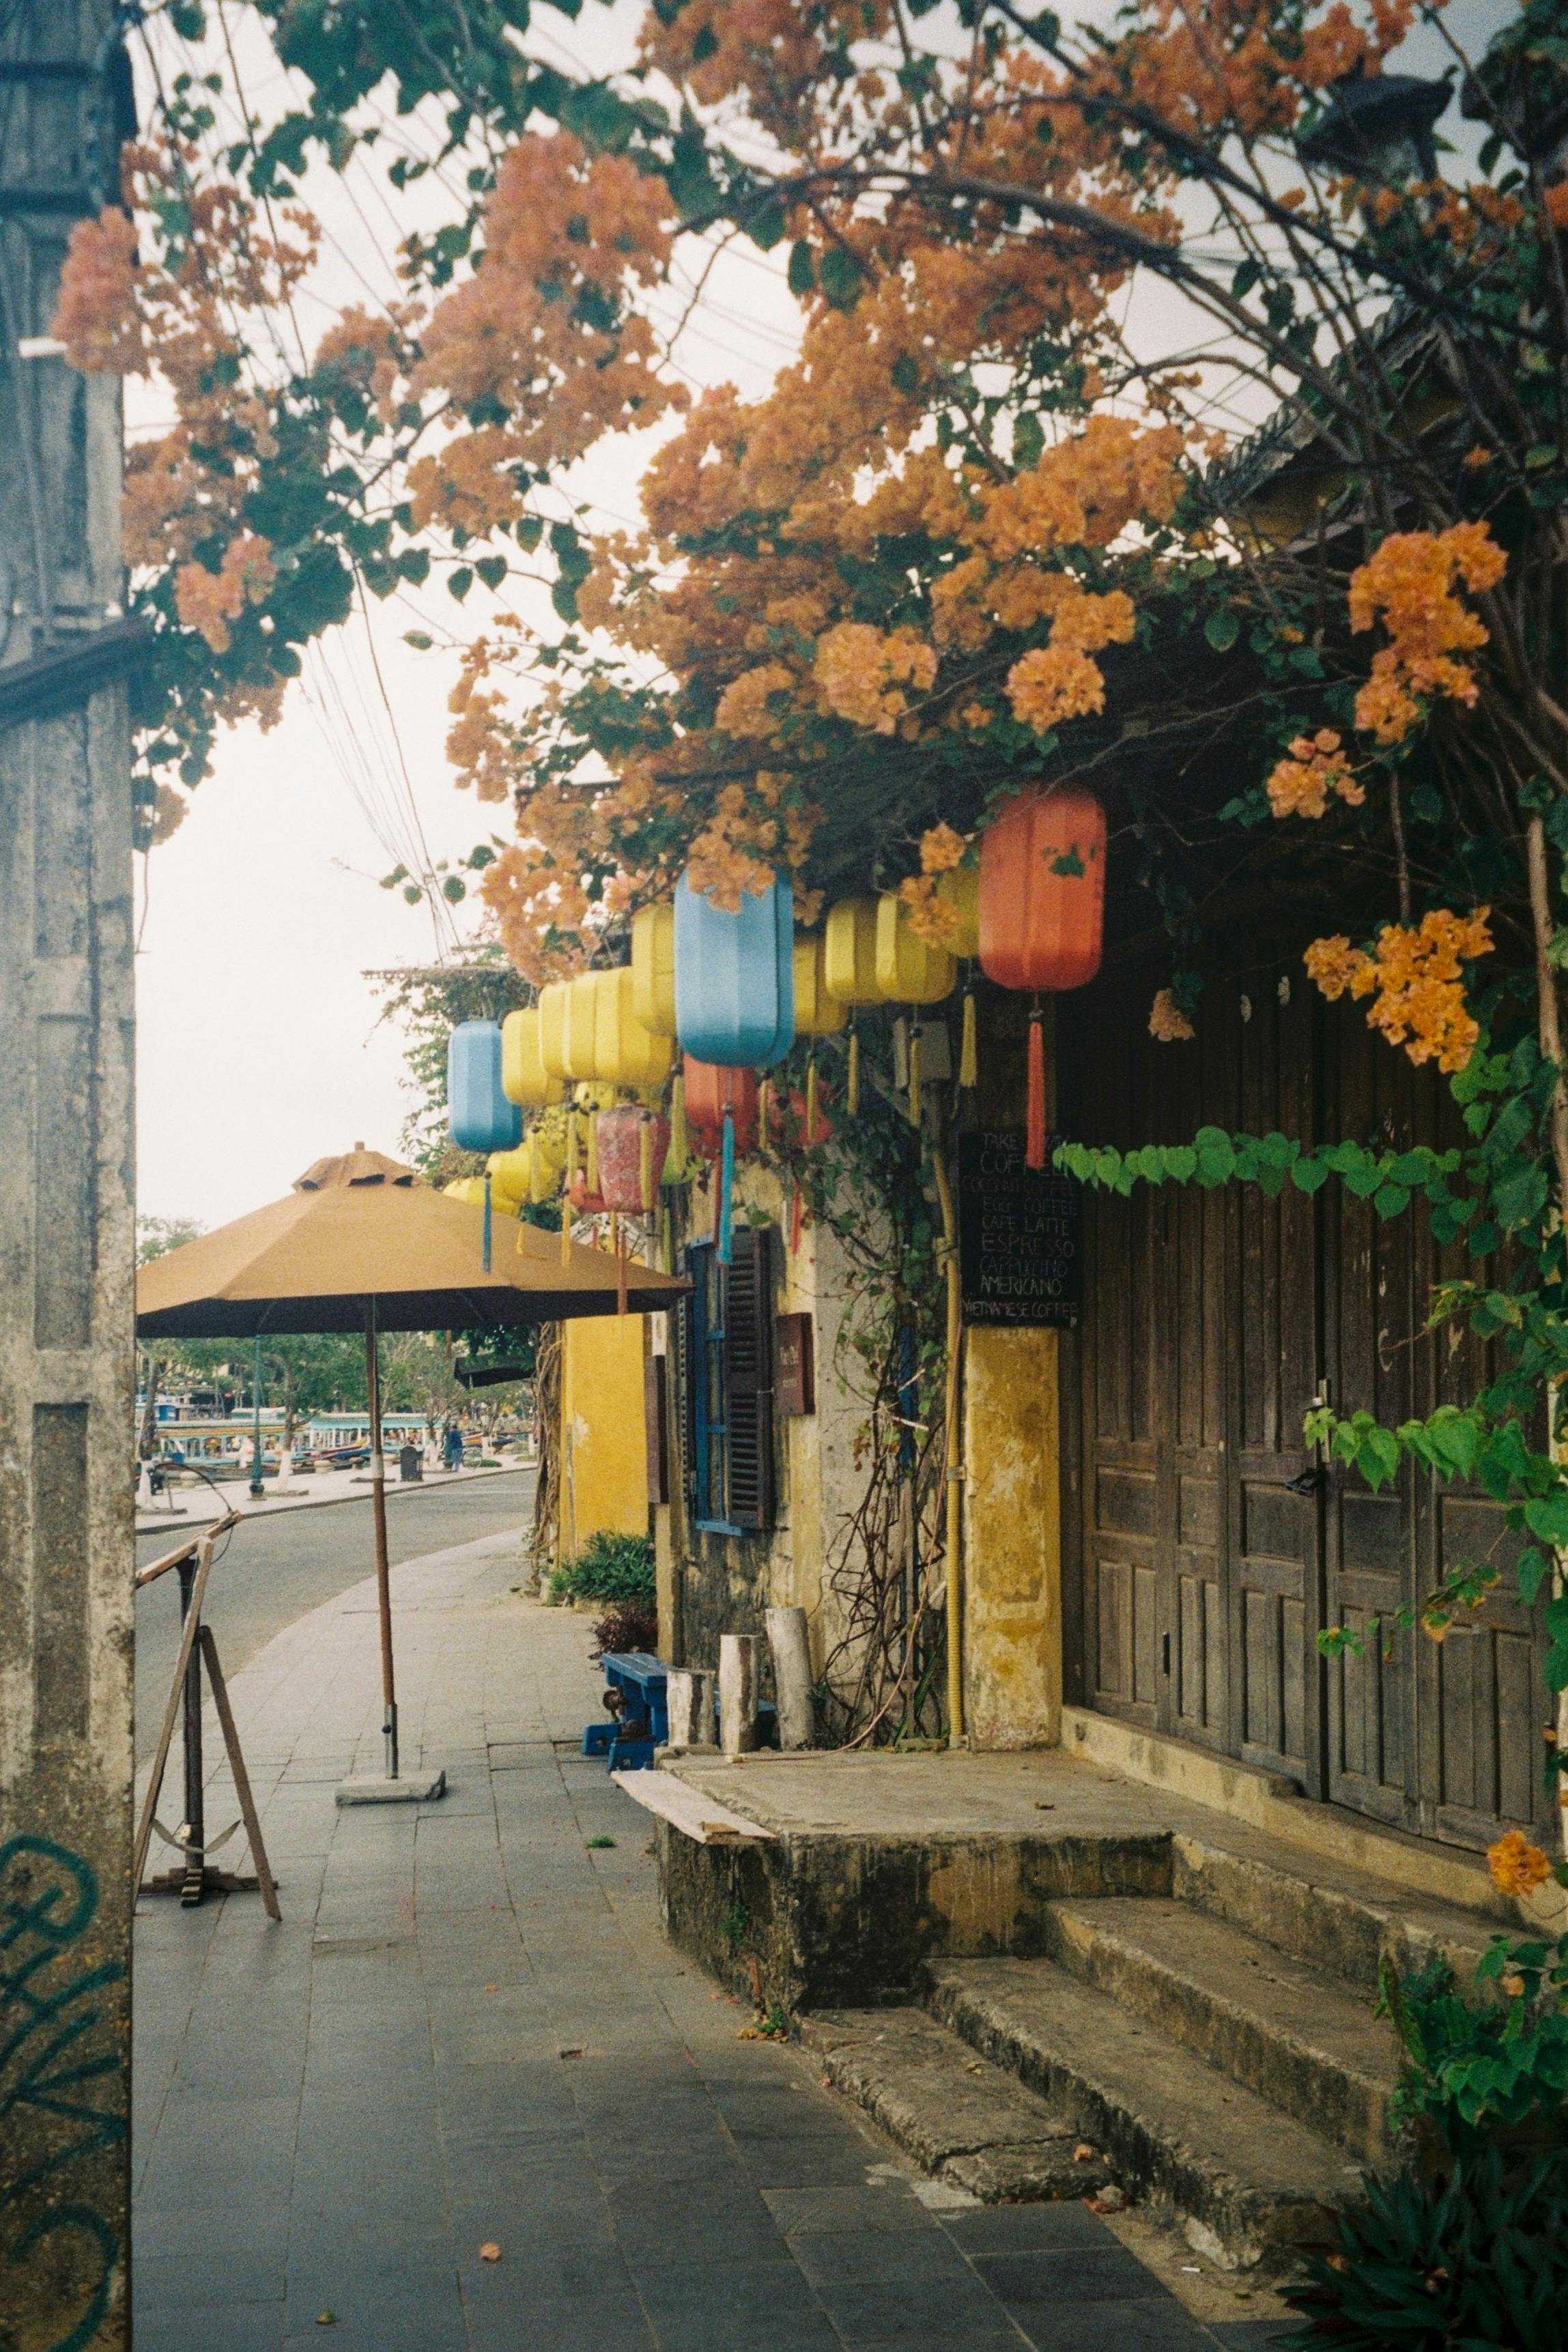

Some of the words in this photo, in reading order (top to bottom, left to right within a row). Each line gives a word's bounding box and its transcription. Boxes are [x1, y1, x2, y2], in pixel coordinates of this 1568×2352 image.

[982, 1132, 1017, 1150] TAKE
[982, 1195, 1013, 1213] EGG
[1024, 1196, 1077, 1215] COFFEE
[982, 1215, 1016, 1232] CAFE
[1025, 1216, 1070, 1236] LATTE
[982, 1233, 1074, 1258] ESPRESSO
[980, 1274, 1062, 1296] AMERICANO
[960, 1297, 1029, 1318] VIETNAMESE
[1031, 1302, 1077, 1318] COFFEE
